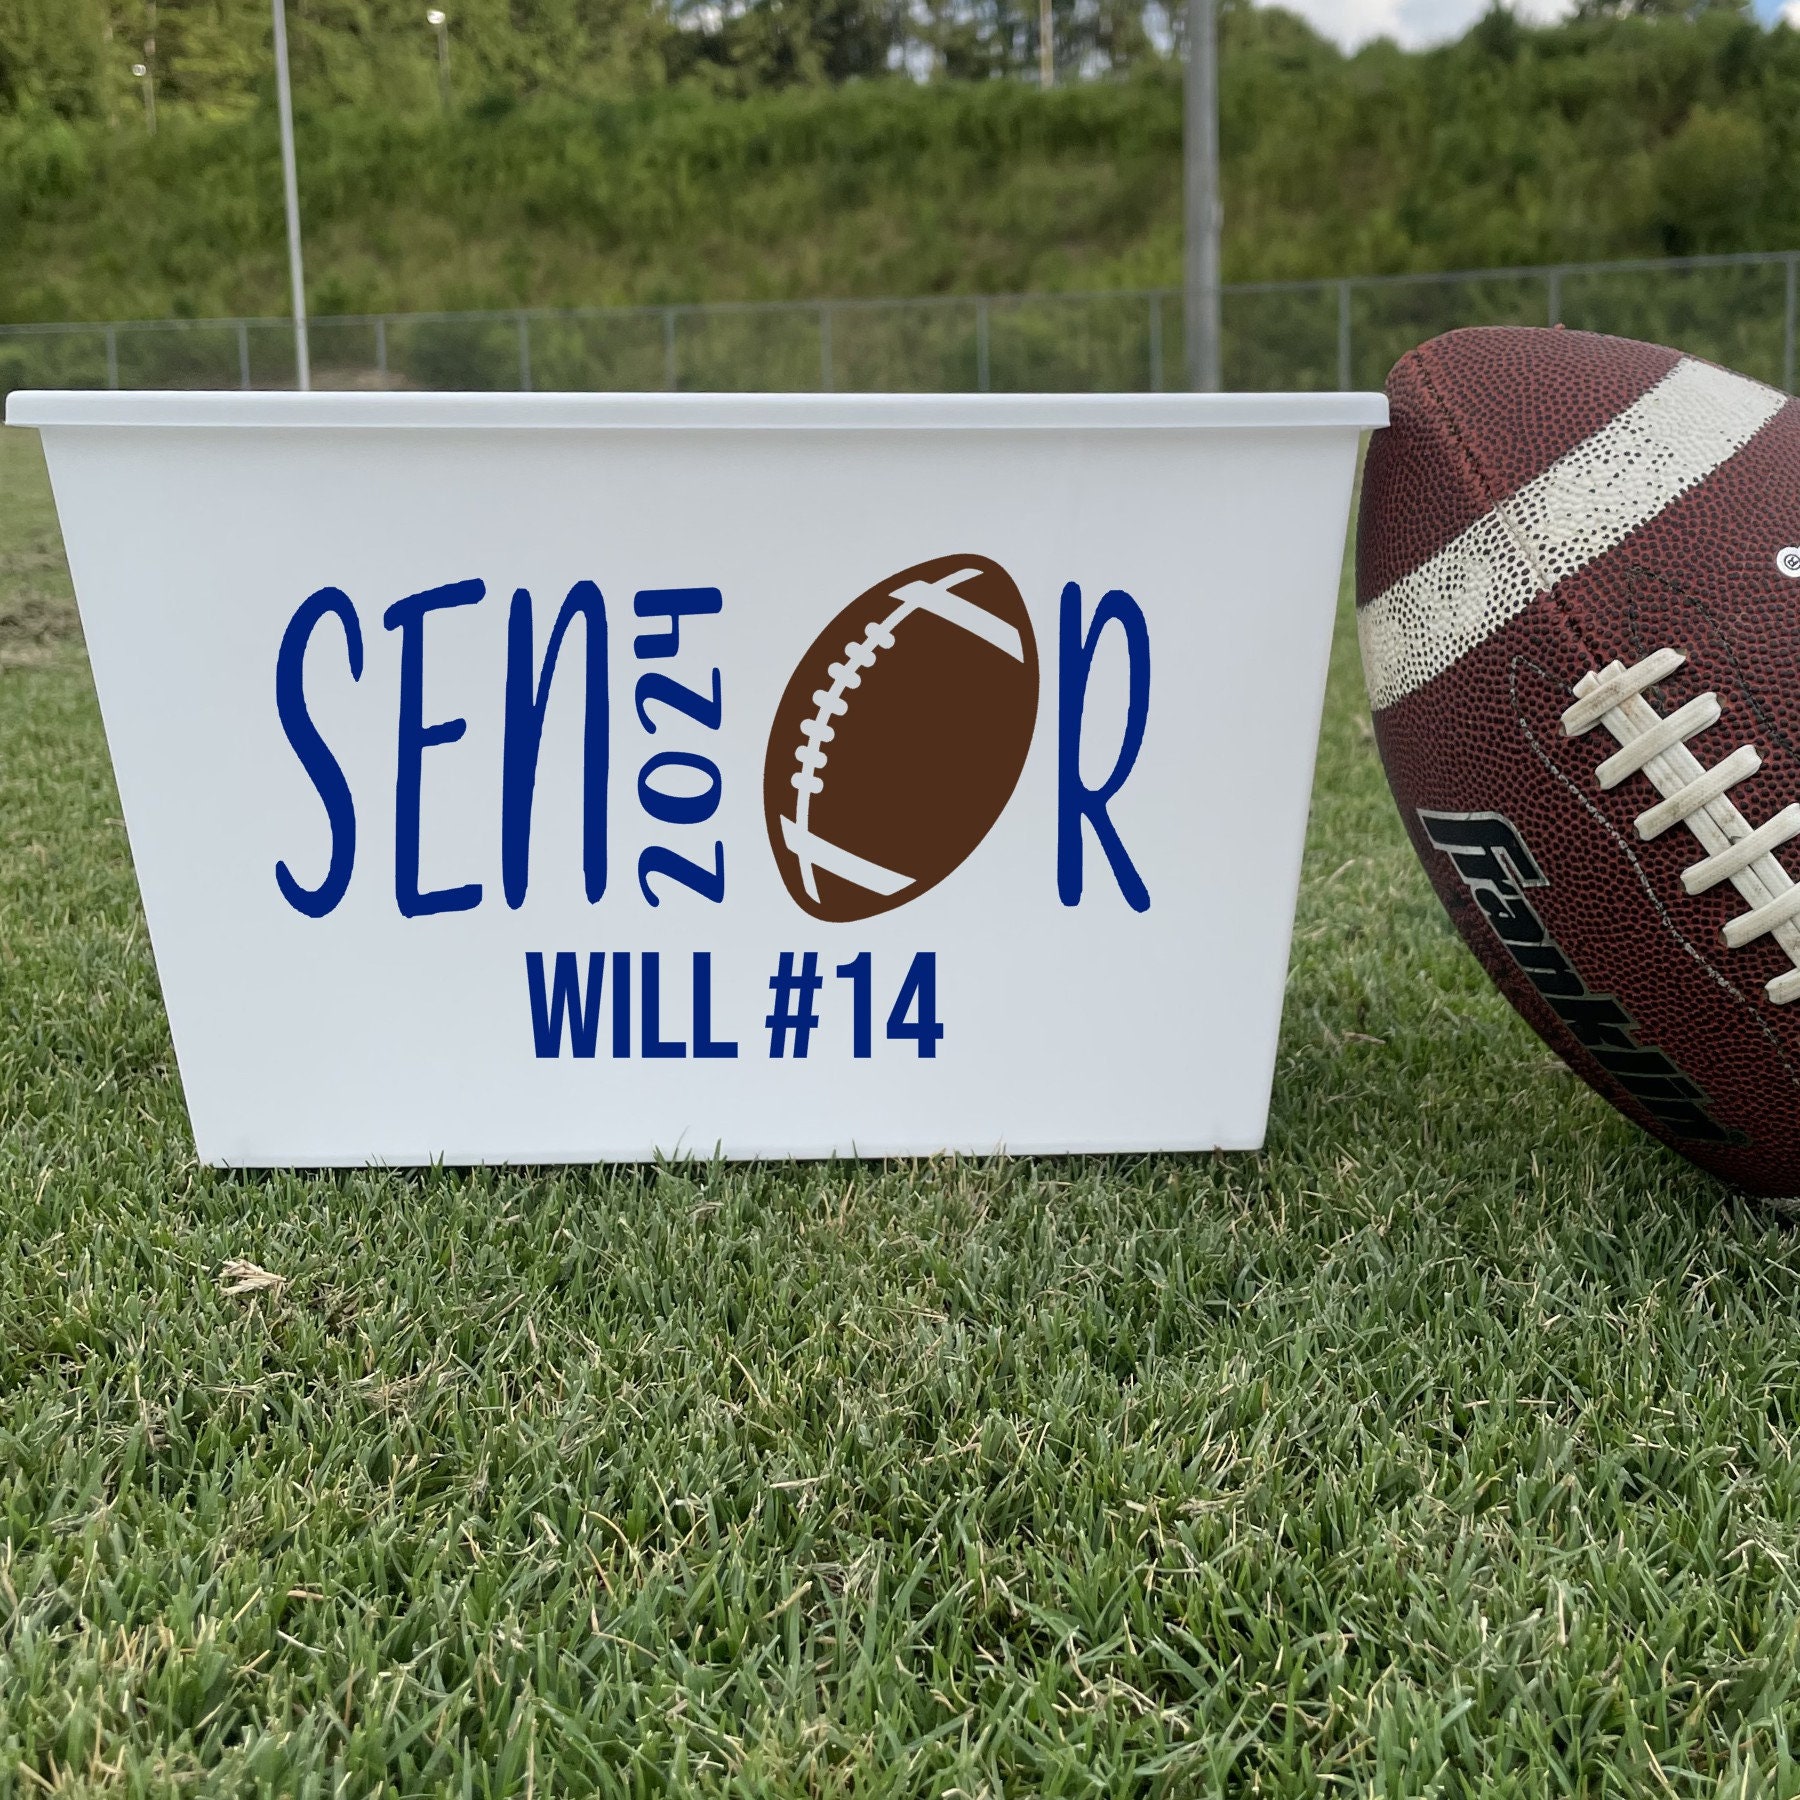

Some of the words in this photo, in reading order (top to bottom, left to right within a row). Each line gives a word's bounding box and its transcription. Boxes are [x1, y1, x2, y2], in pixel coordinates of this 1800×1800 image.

[634, 587, 724, 907] 2024
[526, 952, 738, 1058] WILL
[765, 952, 943, 1058] #14
[1416, 808, 1735, 1145] Franklin
